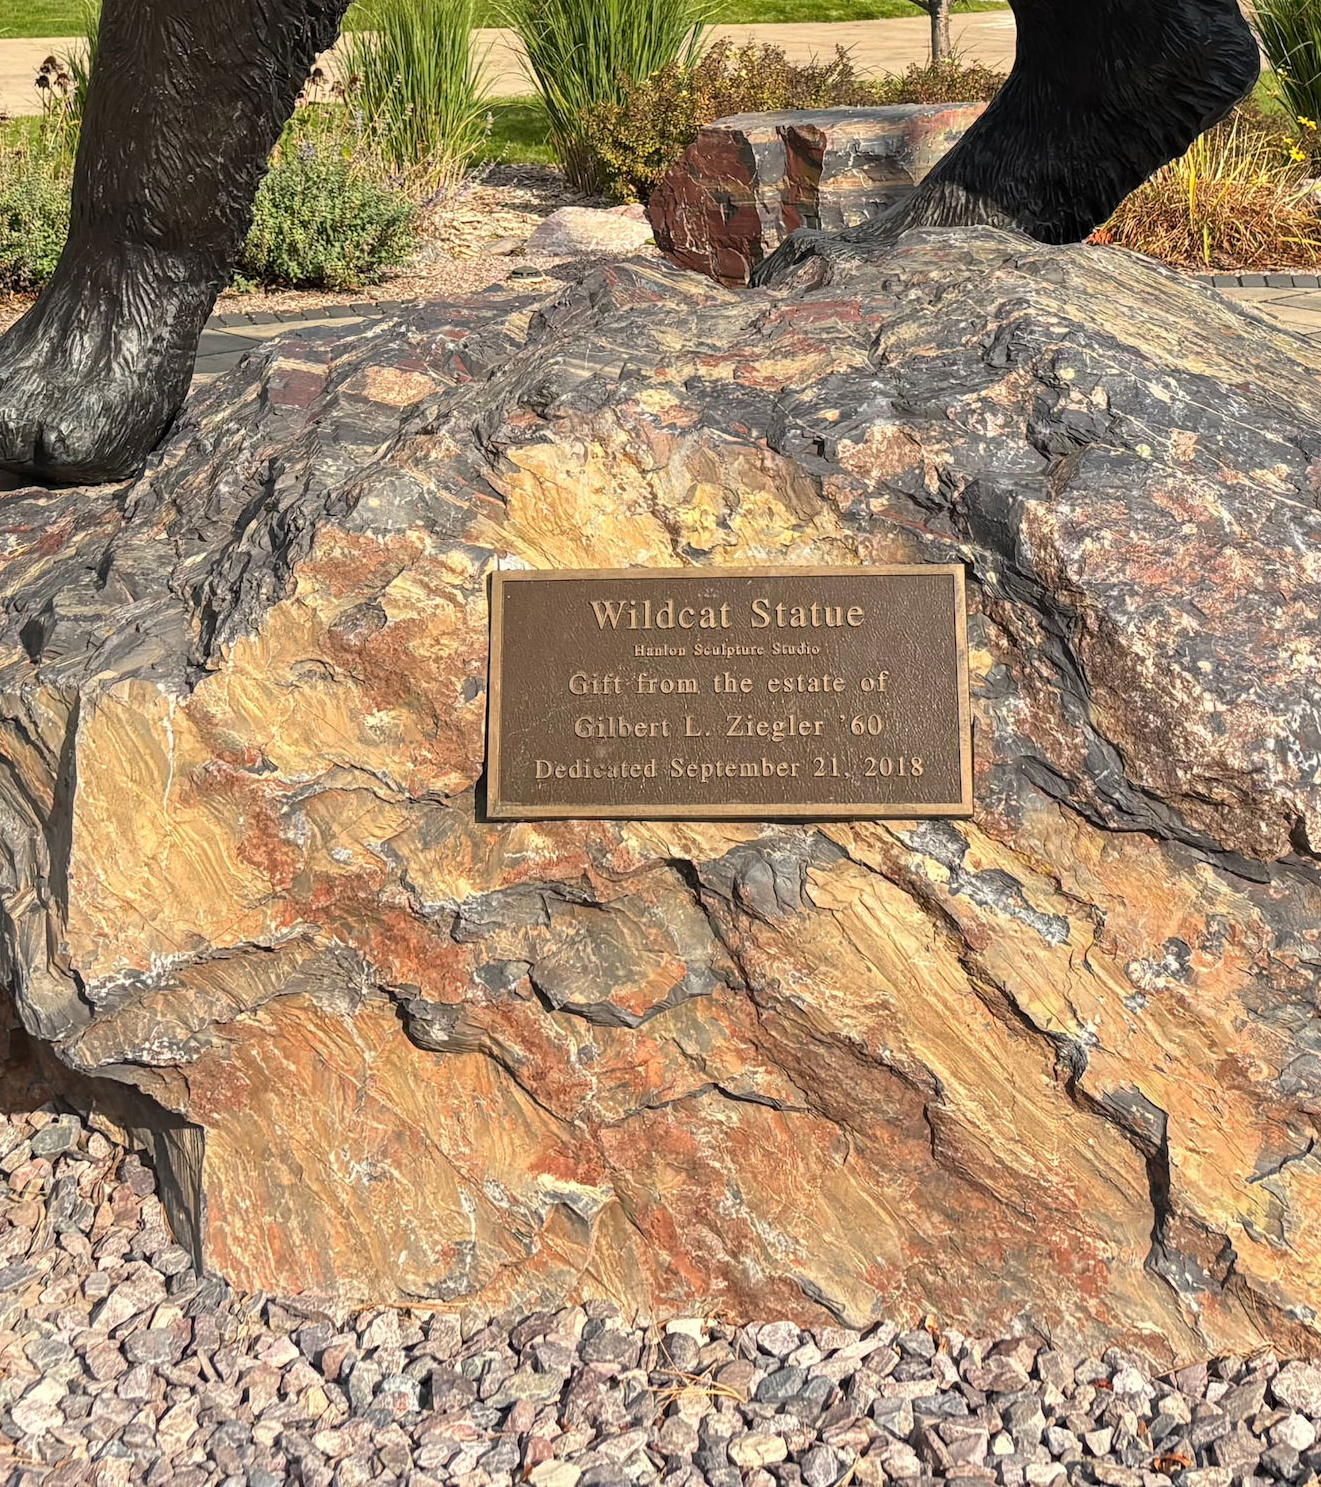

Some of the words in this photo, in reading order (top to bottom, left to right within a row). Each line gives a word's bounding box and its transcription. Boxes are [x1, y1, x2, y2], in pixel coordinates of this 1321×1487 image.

[589, 599, 733, 631] Wildcat
[750, 598, 865, 628] Statue
[633, 644, 687, 657] Hanlon
[693, 643, 764, 659] Sculpture
[771, 642, 821, 656] Studio
[568, 673, 623, 696] Gift
[635, 673, 698, 695] from
[713, 671, 754, 694] the
[767, 673, 847, 693] estate
[860, 669, 890, 693] of
[573, 716, 671, 739] Gilbert
[683, 715, 711, 738] L.
[726, 714, 824, 743] Ziegler
[839, 714, 884, 737] '60
[534, 758, 658, 780] Dedicated
[669, 756, 801, 784] September
[812, 756, 851, 781] 21,
[863, 755, 925, 778] 2018
